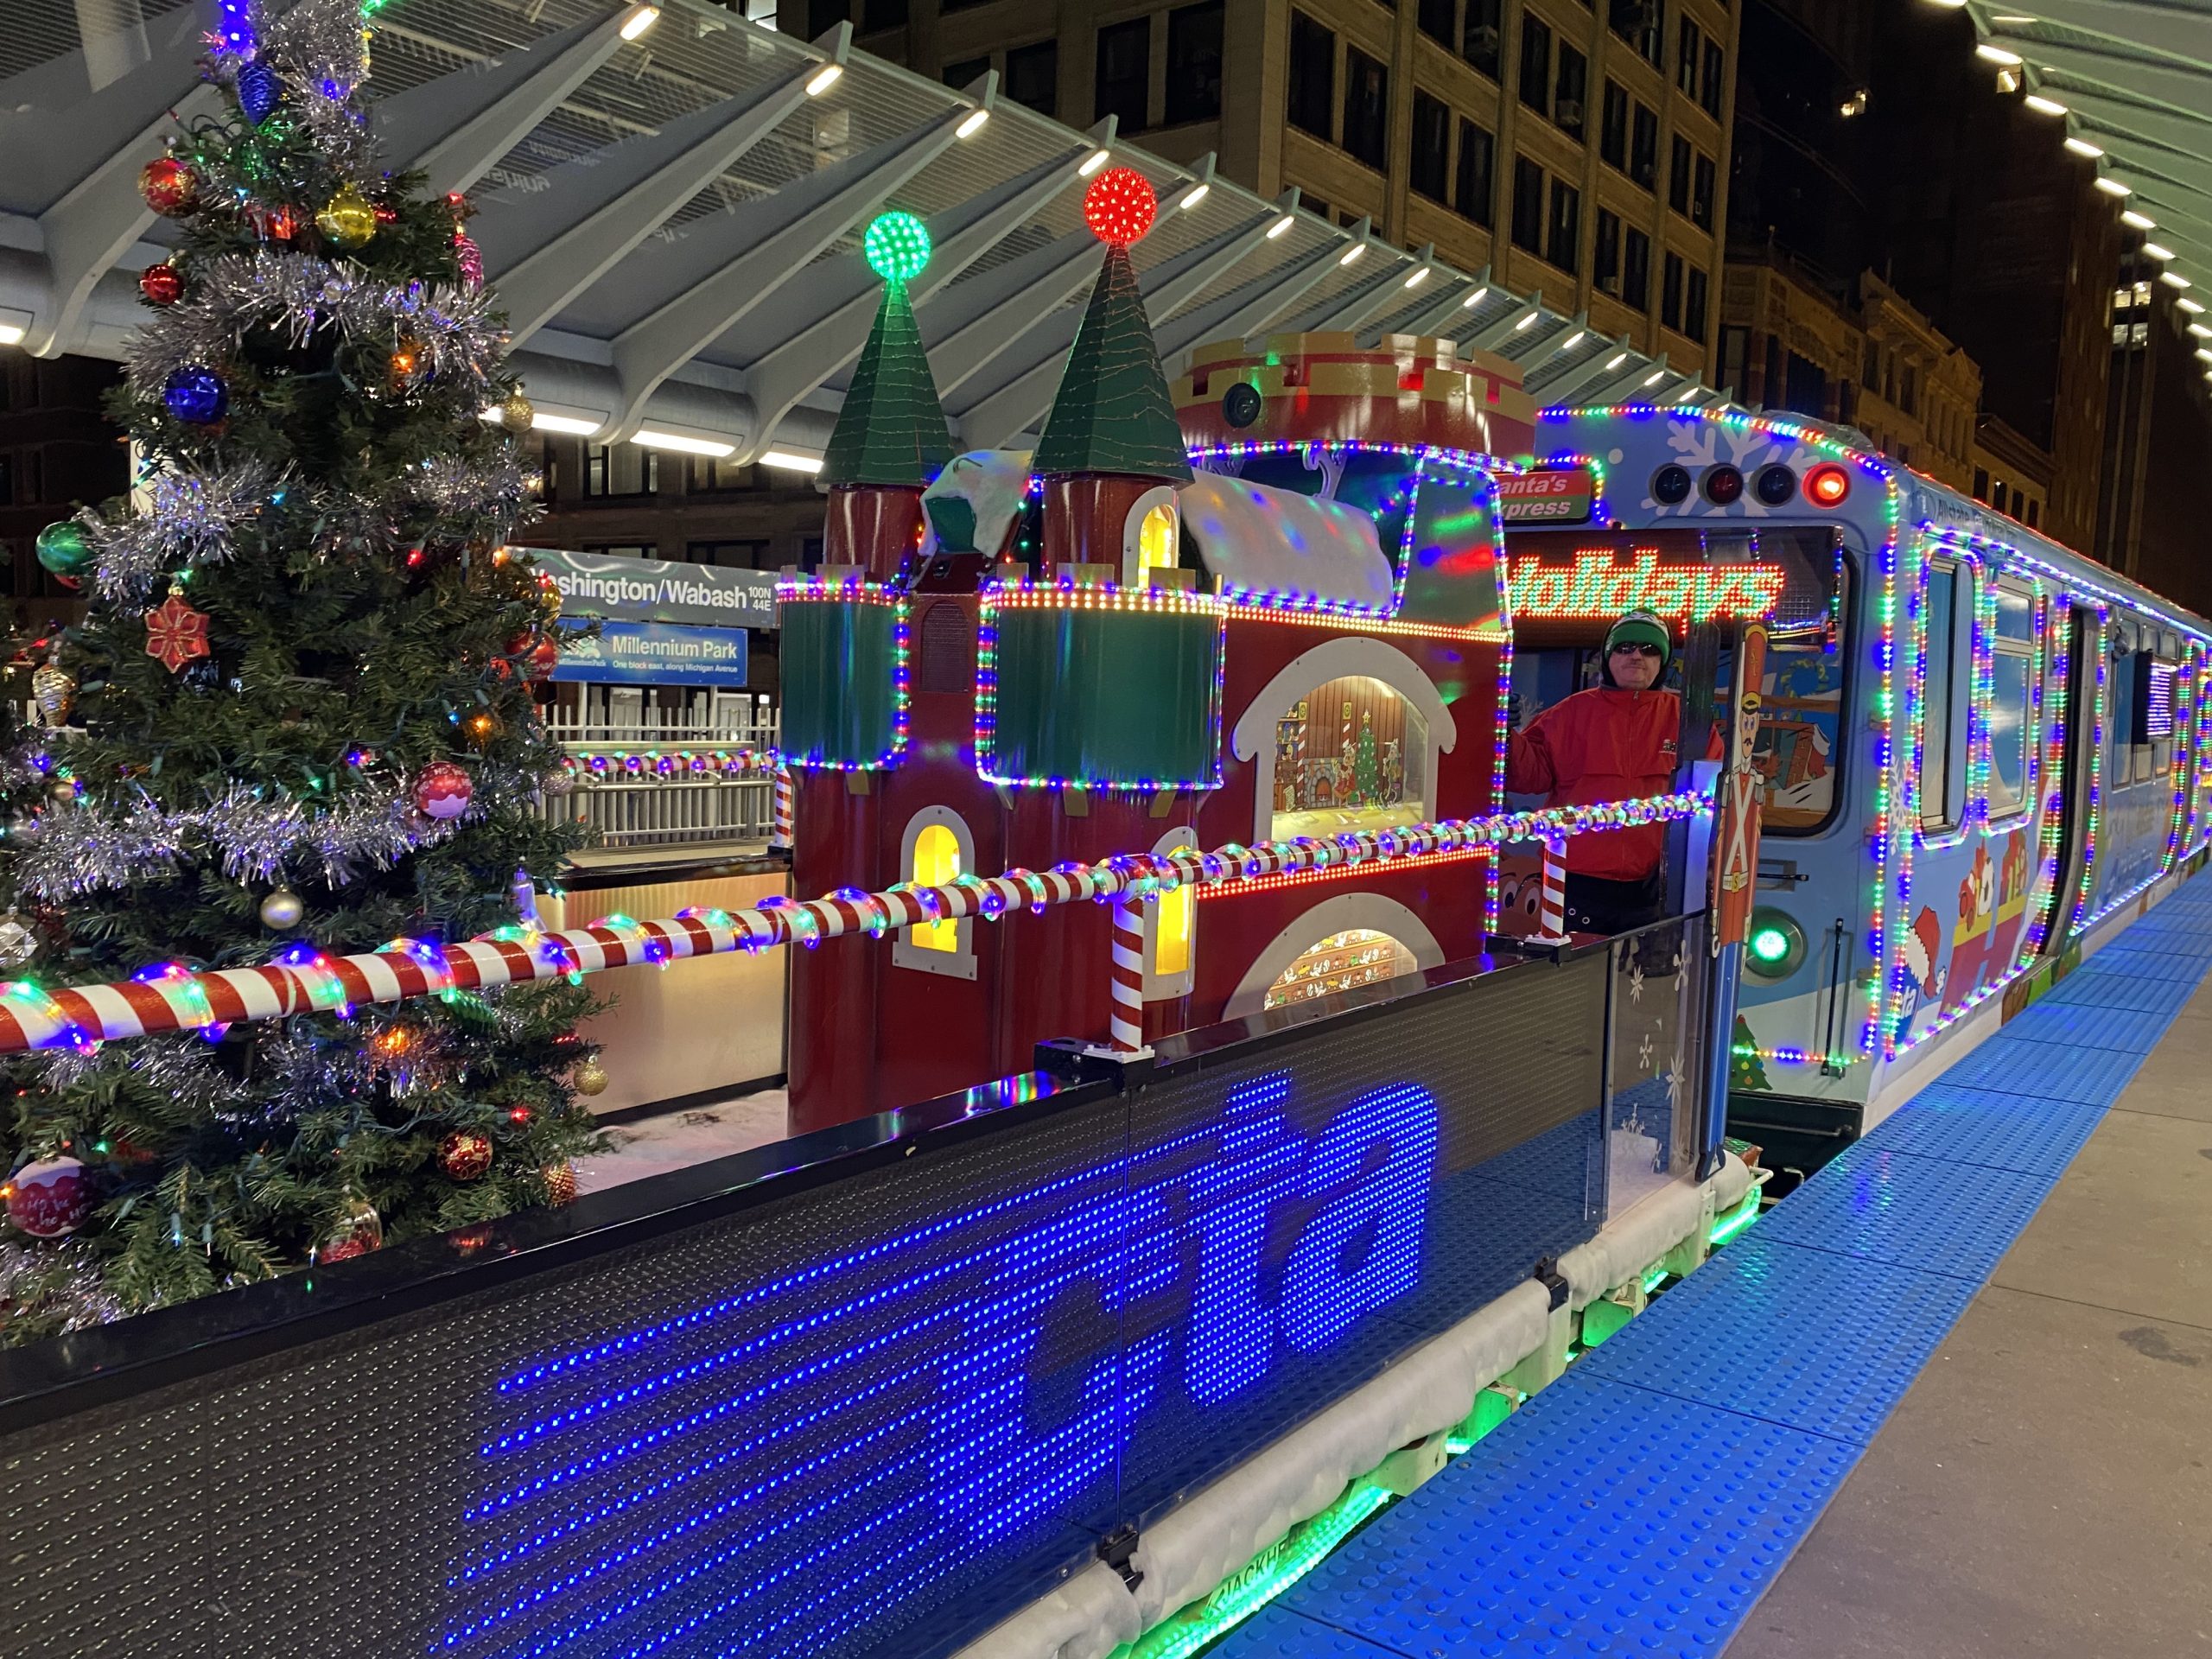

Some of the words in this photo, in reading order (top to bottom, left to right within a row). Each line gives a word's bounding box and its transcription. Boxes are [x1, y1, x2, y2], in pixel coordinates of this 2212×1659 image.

[1500, 475, 1567, 494] anta's
[1501, 501, 1571, 520] press
[748, 587, 771, 599] 100N
[753, 599, 771, 611] 44E
[613, 636, 698, 657] Millennium
[703, 640, 737, 658] Park
[613, 660, 627, 669] One
[628, 661, 647, 670] block
[648, 662, 664, 671] east,
[665, 663, 684, 672] along
[685, 664, 714, 673] Michigan
[929, 1068, 1438, 1547] cta
